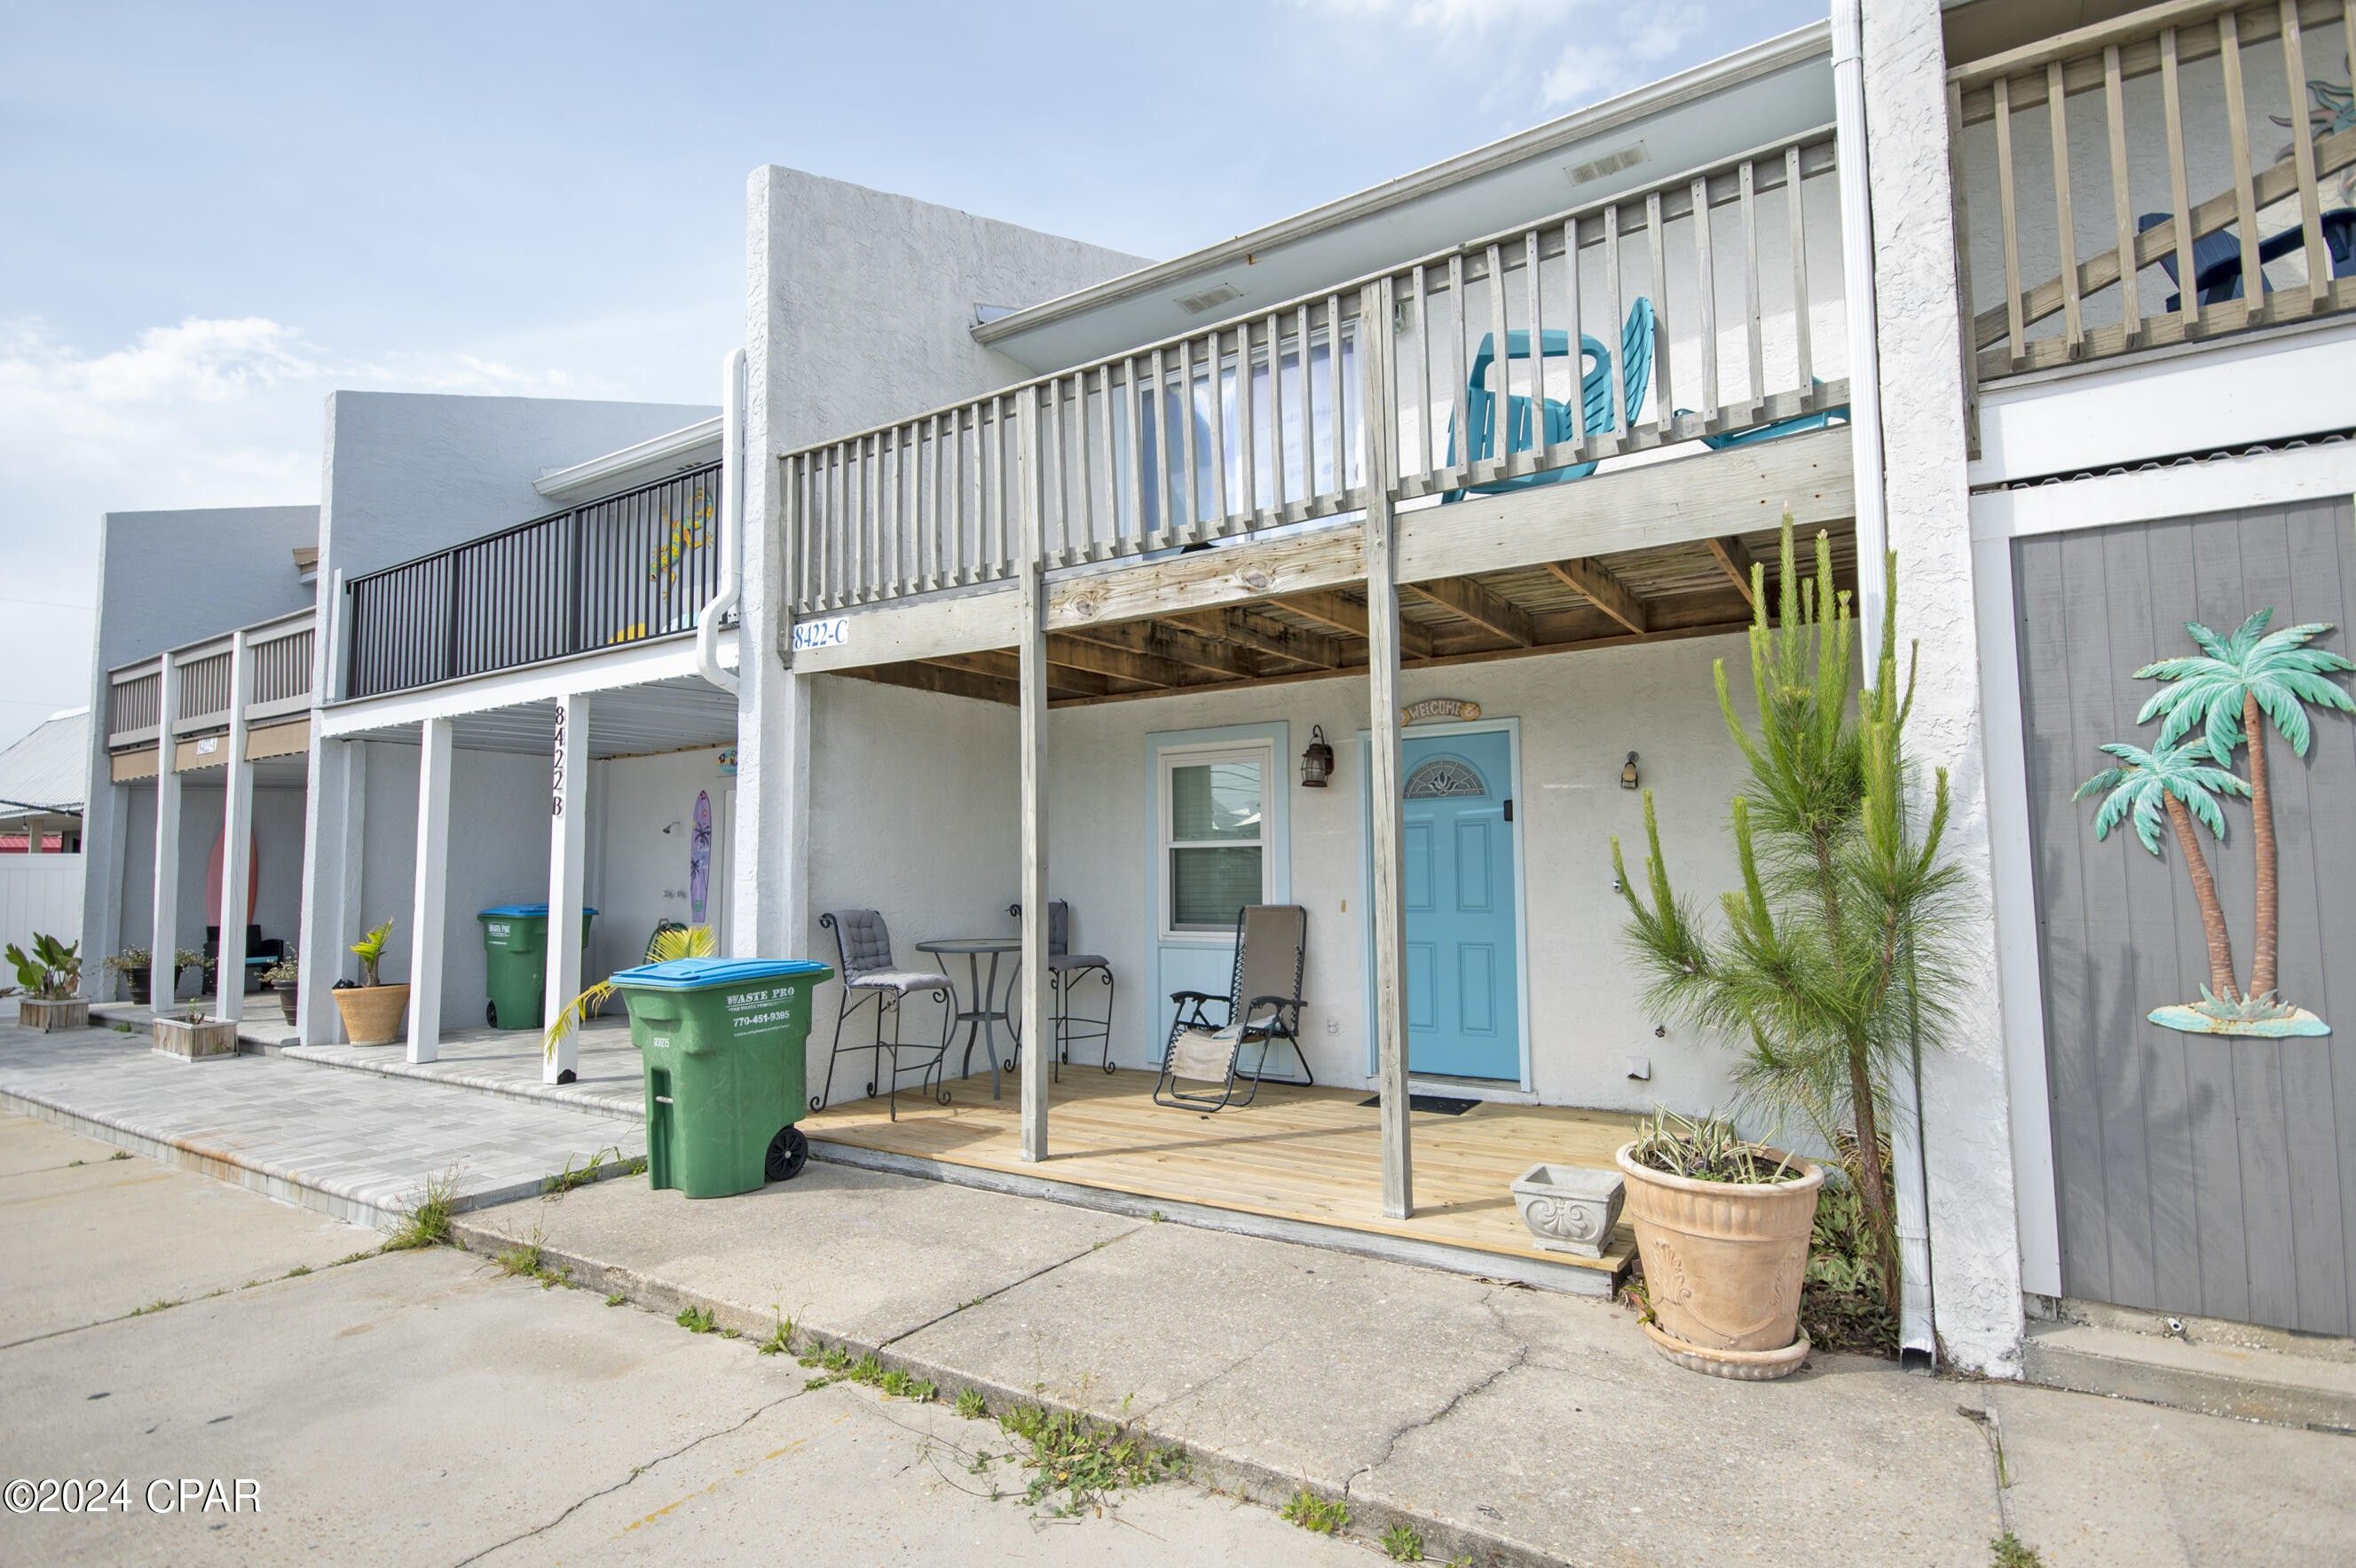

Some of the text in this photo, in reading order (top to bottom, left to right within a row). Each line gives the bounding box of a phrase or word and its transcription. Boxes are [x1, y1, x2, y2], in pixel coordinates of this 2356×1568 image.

[794, 619, 848, 650] 8422-C
[1408, 700, 1462, 720] WELCOME
[727, 990, 768, 1005] WASTE
[772, 986, 795, 999] PRO
[733, 1010, 790, 1028] 770-451-9395
